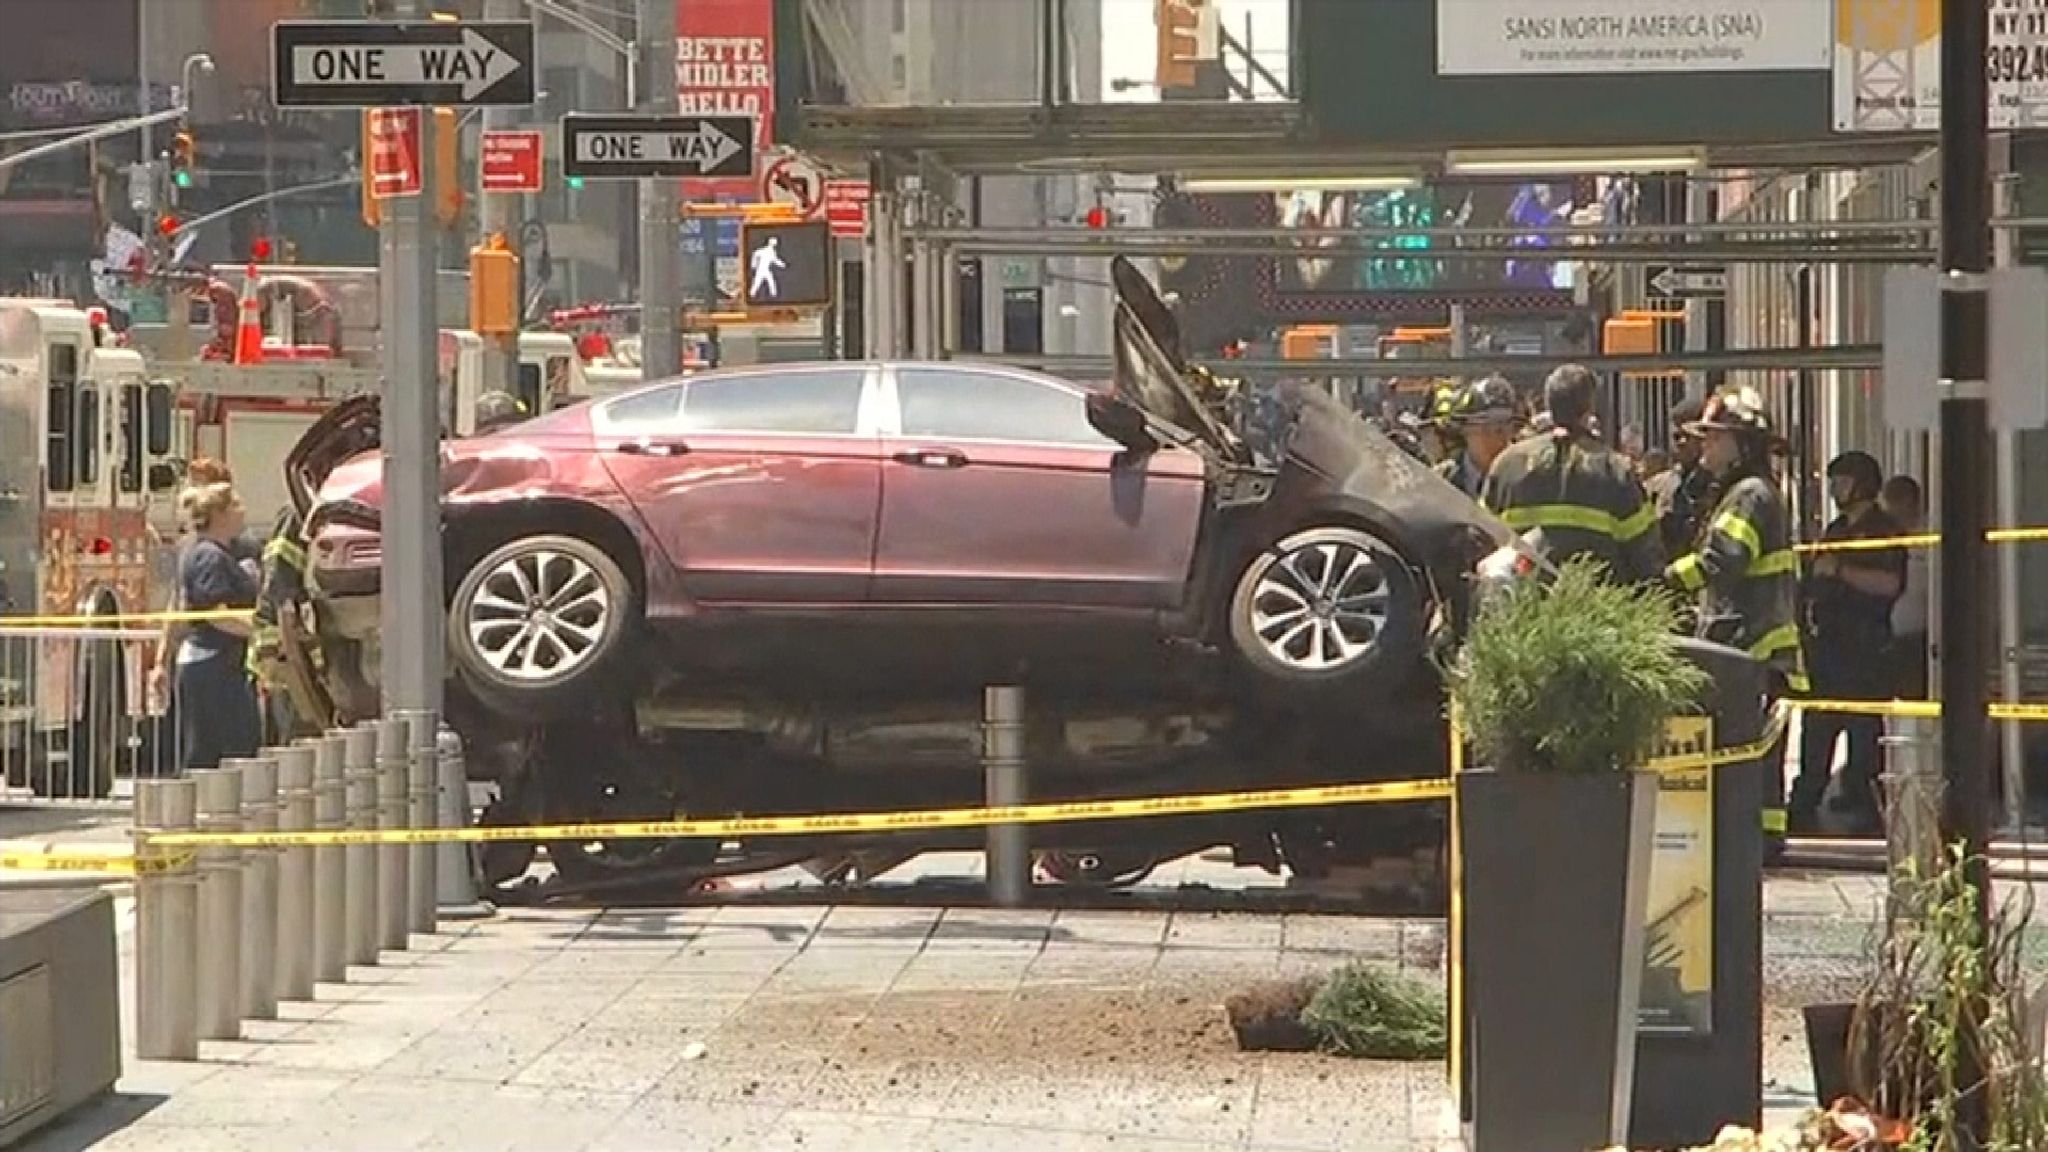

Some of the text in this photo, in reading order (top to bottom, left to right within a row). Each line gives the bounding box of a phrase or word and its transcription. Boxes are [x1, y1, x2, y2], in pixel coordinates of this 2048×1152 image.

[1505, 12, 1763, 40] SANSI NORTH AMERICA (SNA)
[678, 37, 764, 61] BETTE
[312, 49, 495, 80] ONE WAY
[676, 63, 770, 87] MIDLER
[590, 135, 723, 159] ONE WAY
